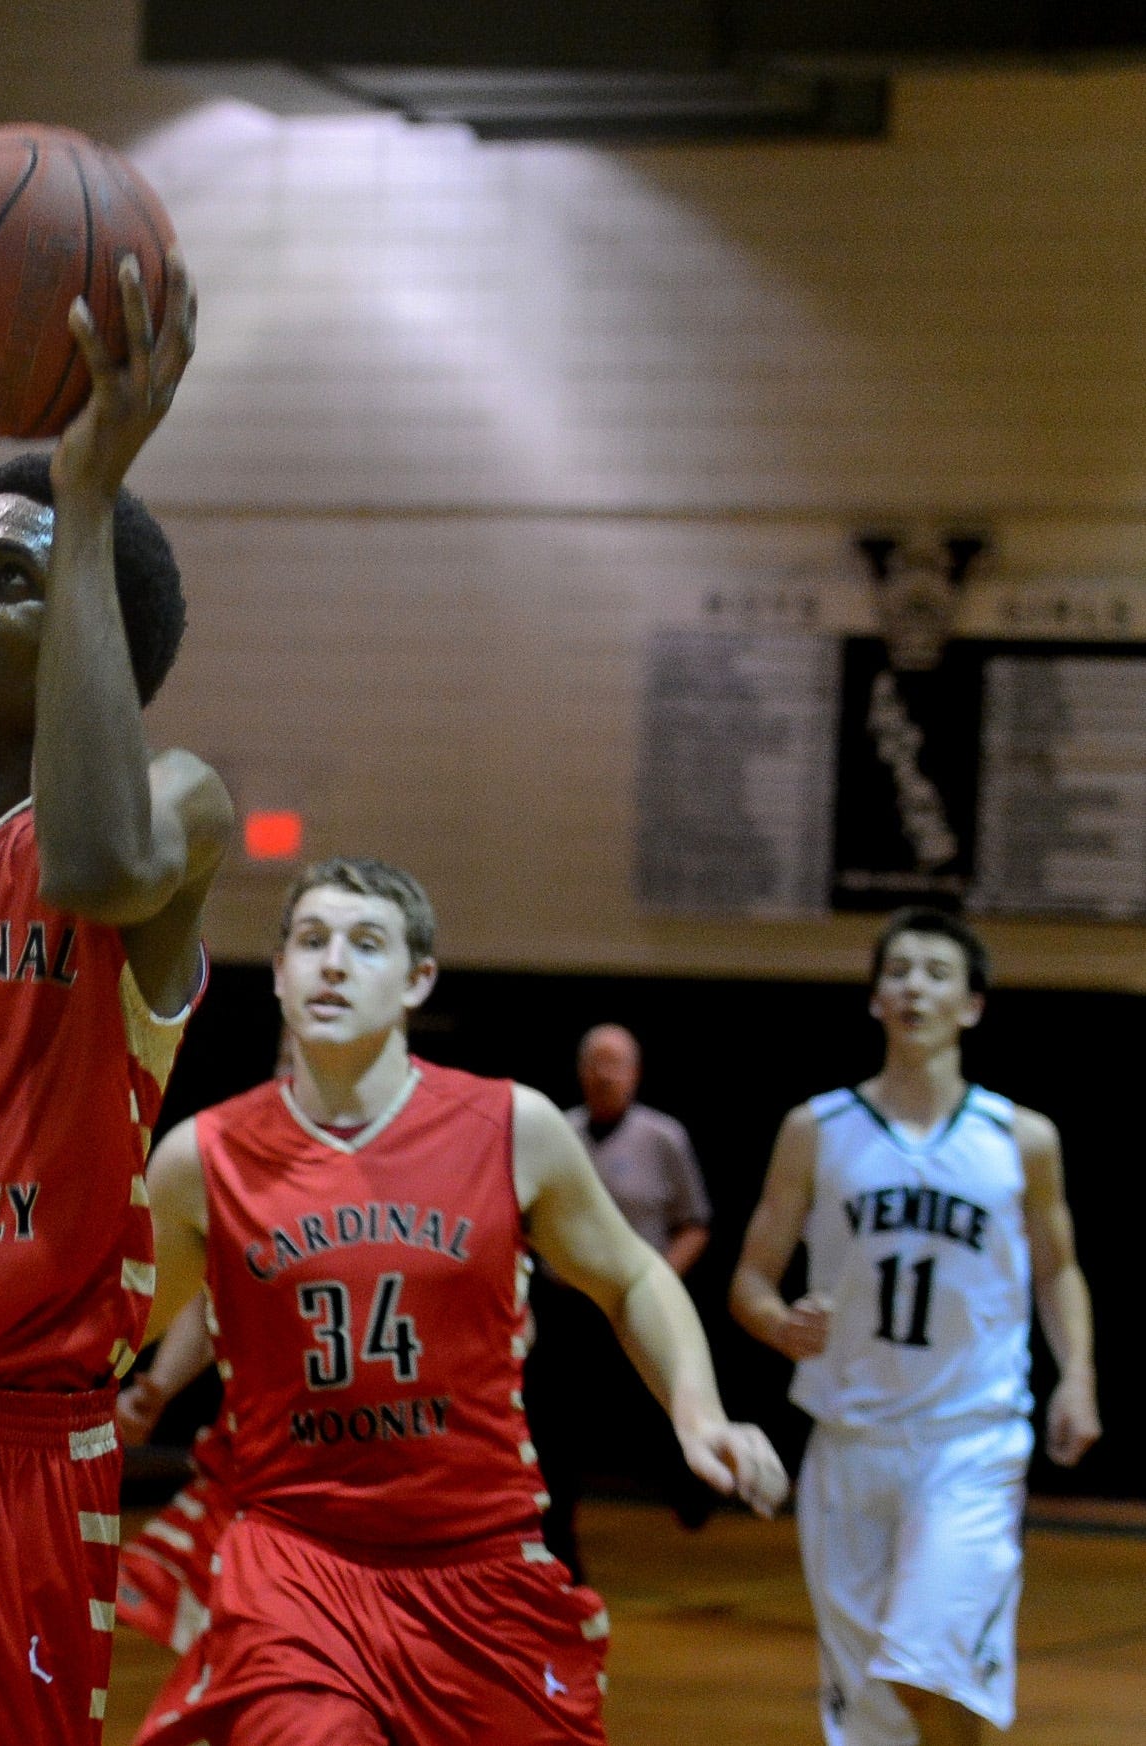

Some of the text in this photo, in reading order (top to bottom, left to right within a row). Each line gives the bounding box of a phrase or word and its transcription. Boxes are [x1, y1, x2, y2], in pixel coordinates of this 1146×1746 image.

[245, 1202, 473, 1281] CARDINAL
[843, 1186, 990, 1253] VENICE
[297, 1272, 424, 1392] 34
[874, 1251, 935, 1347] 11
[290, 1396, 454, 1446] MOONEY
